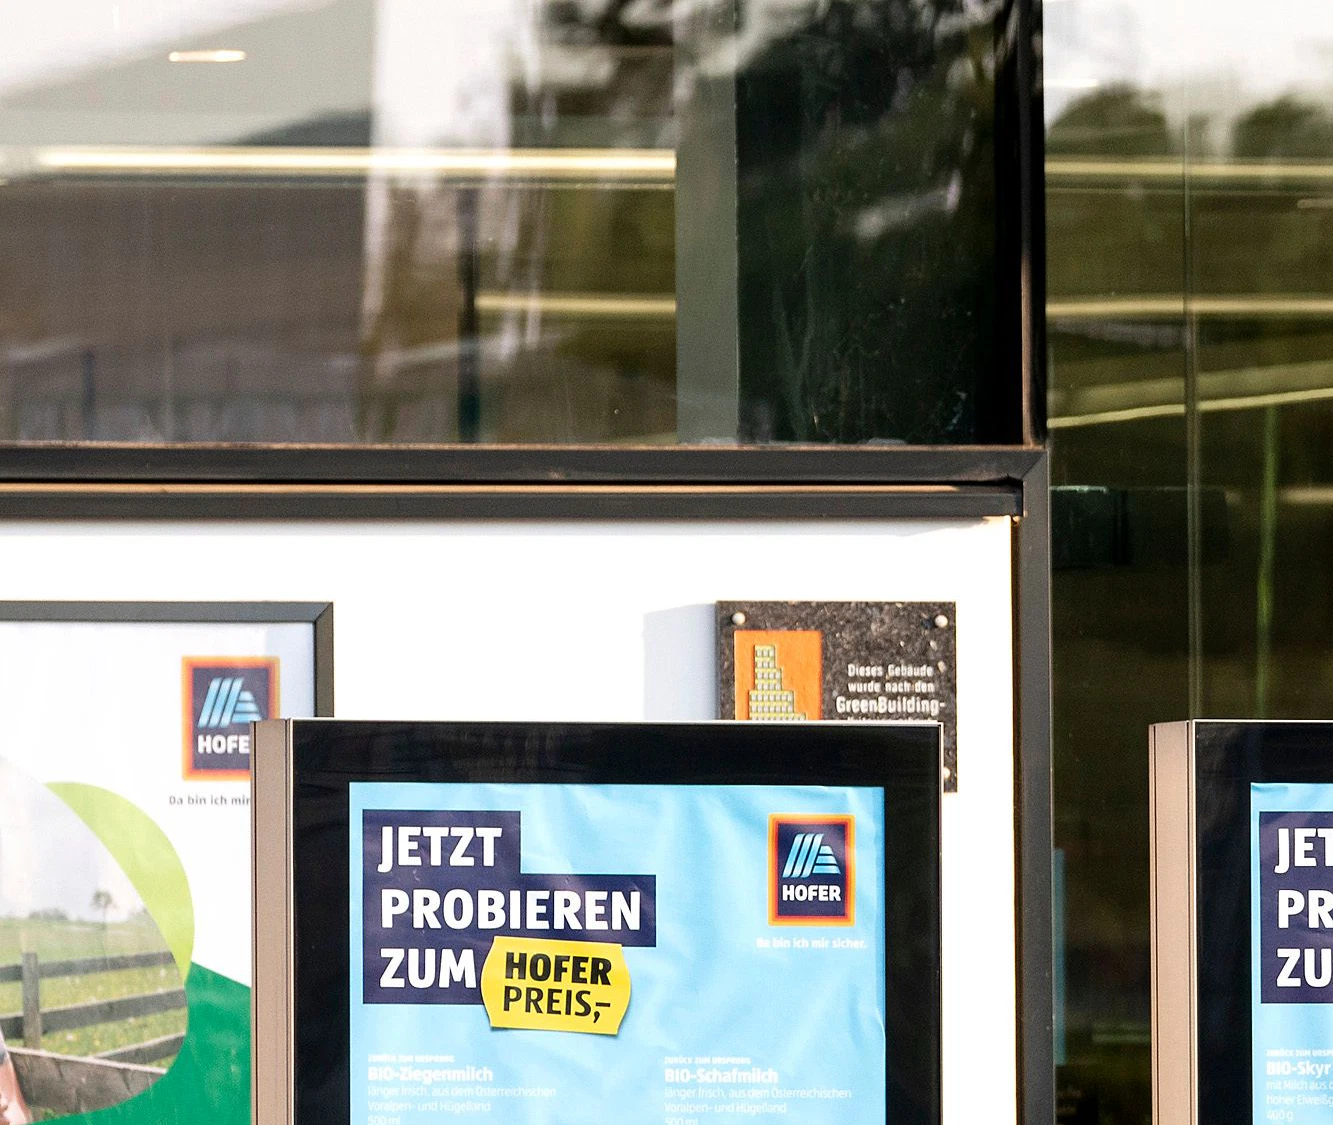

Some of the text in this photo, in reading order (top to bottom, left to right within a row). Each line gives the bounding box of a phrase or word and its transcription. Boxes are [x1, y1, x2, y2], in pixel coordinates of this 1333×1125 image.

[847, 663, 883, 677] Dieses
[848, 681, 935, 693] wurde nach den
[836, 696, 946, 716] GreenBuilding-
[198, 734, 250, 754] HOFE
[169, 795, 183, 805] Da
[188, 795, 206, 805] bin
[211, 795, 227, 805] ich
[377, 826, 503, 873] JETZT
[782, 884, 842, 901] HOFER
[380, 888, 642, 931] PROBIEREN
[379, 948, 477, 989] ZUM
[504, 951, 612, 986] HOFER
[503, 985, 611, 1023] PREIS,-
[368, 1065, 493, 1084] BIO-Ziegenmilch
[664, 1067, 779, 1084] BIO-Schafmilch
[1266, 1061, 1331, 1078] BIO-Skyr
